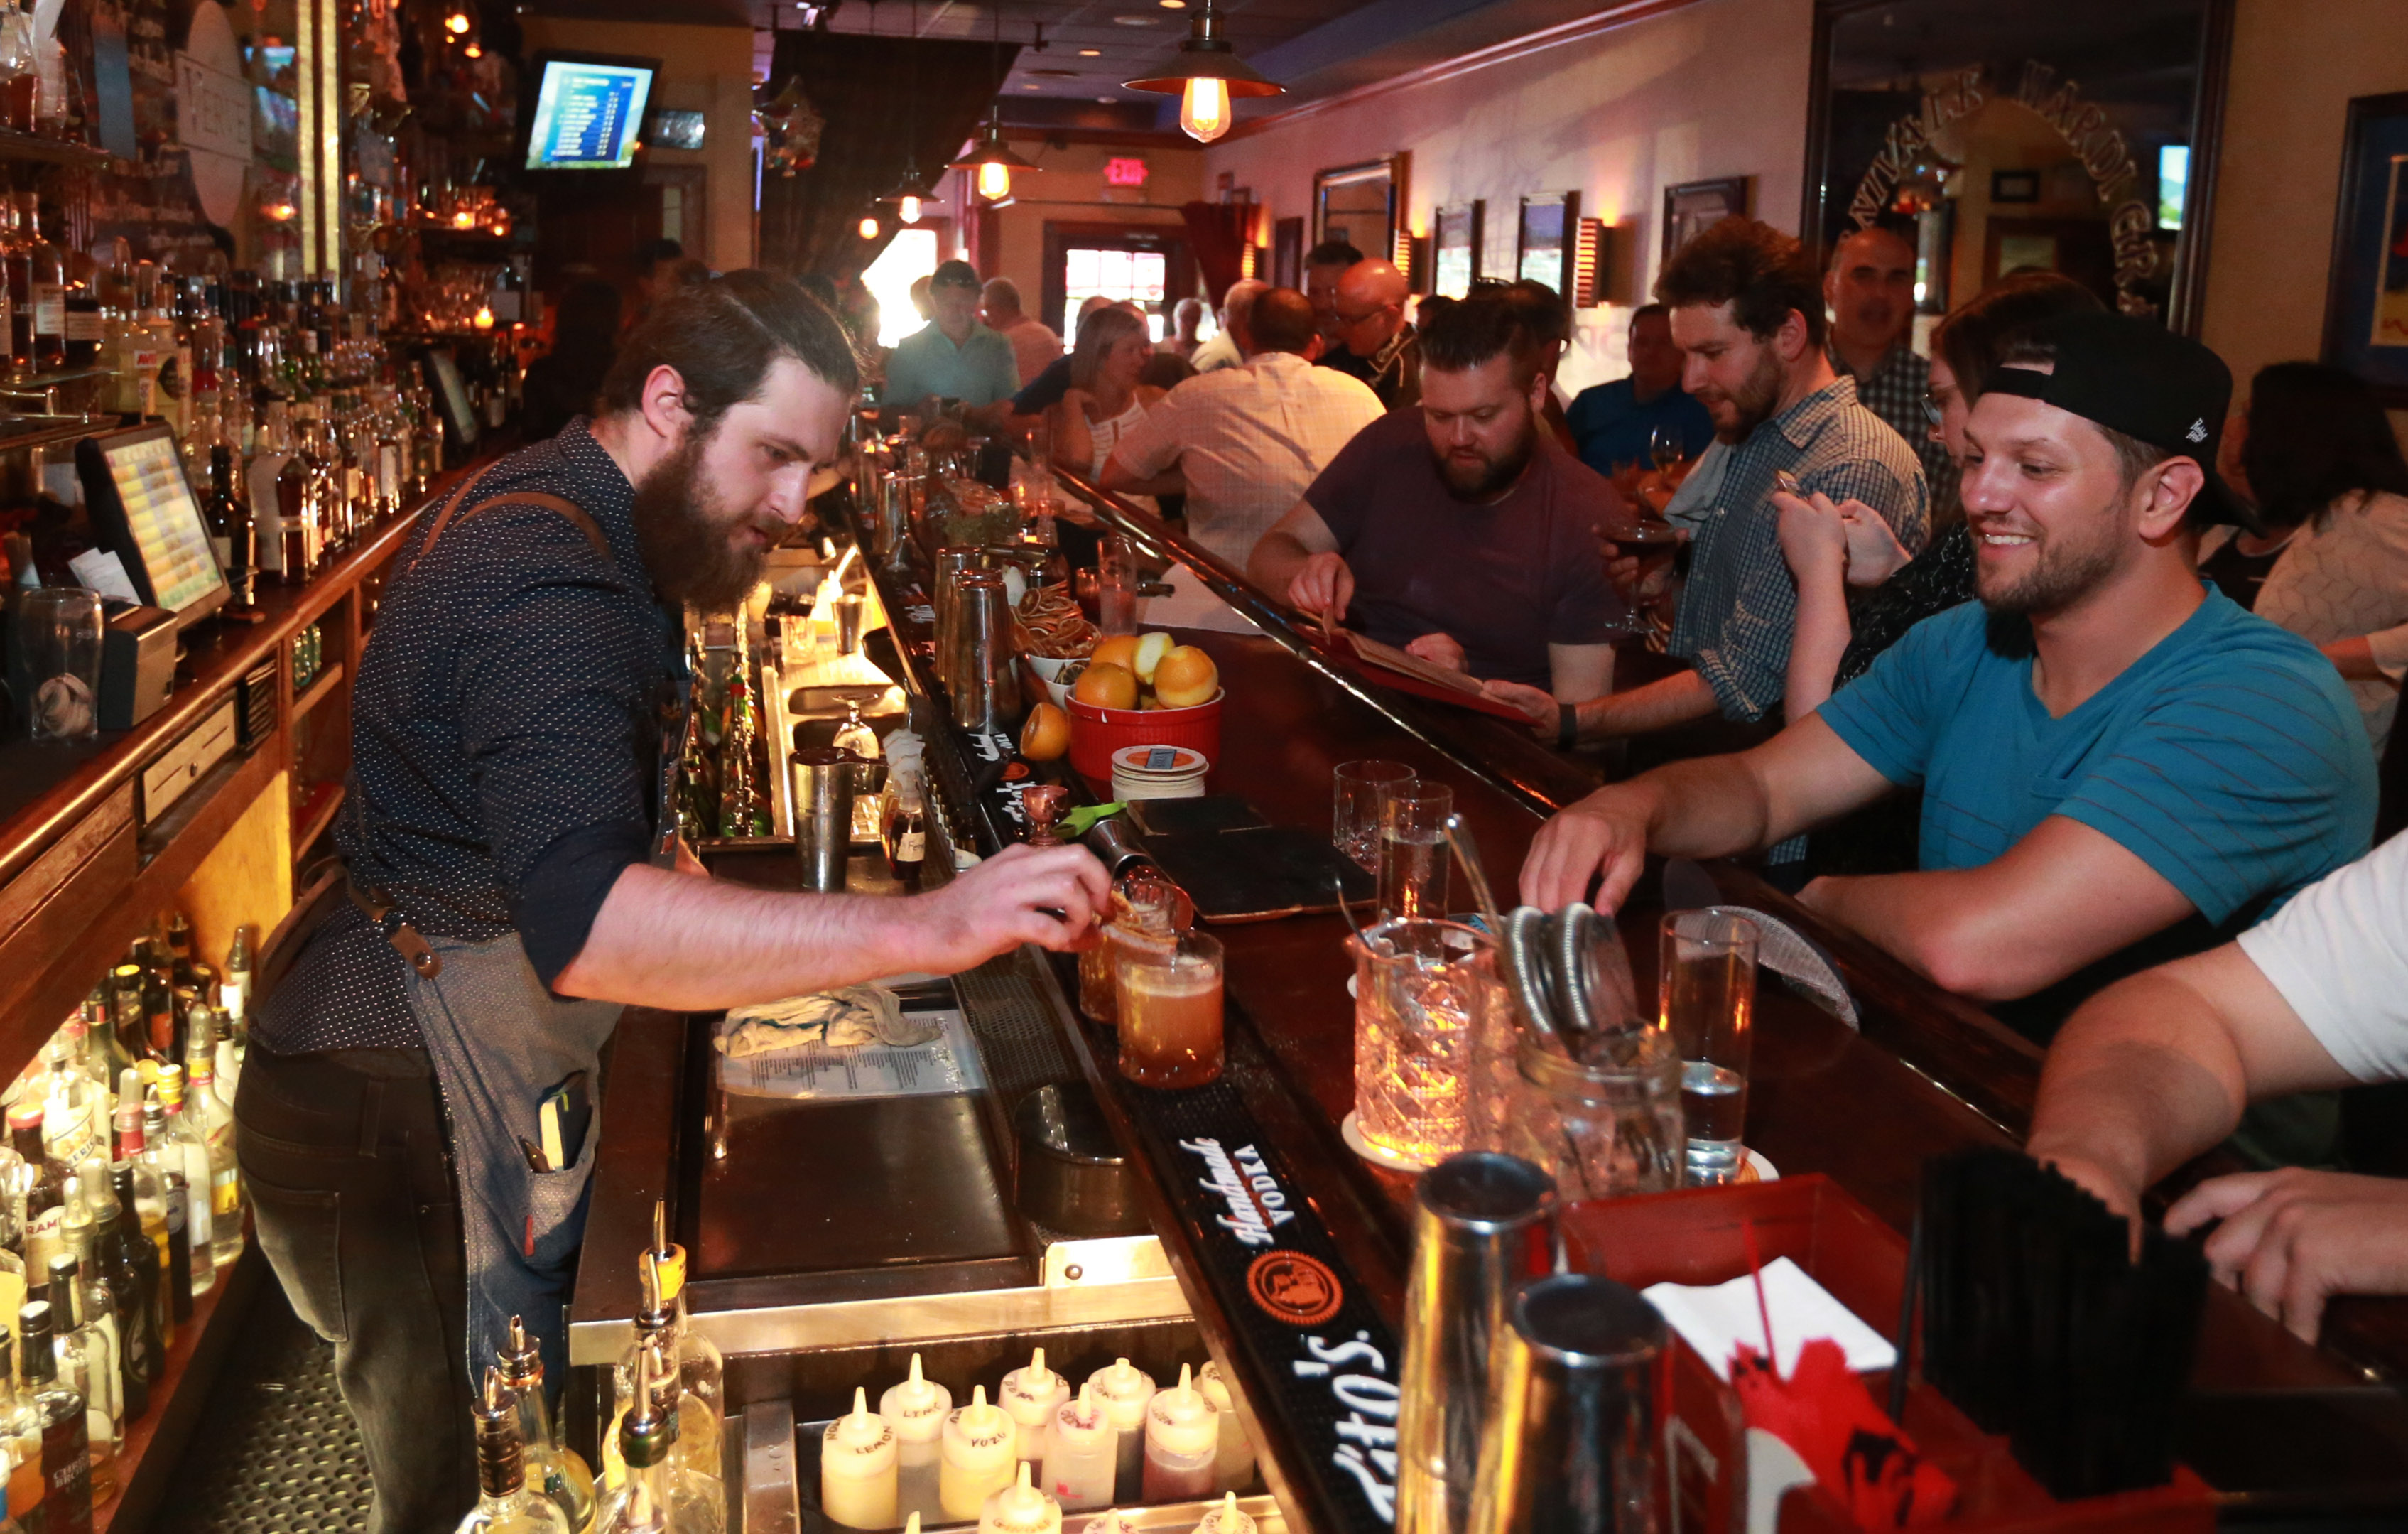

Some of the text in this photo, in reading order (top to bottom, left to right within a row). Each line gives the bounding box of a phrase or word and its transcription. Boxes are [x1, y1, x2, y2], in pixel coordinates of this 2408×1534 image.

[1179, 1137, 1274, 1247] Handmade
[1234, 1143, 1295, 1228] VODKA
[855, 1425, 894, 1454] LEMON
[971, 1432, 1007, 1448] YUZU
